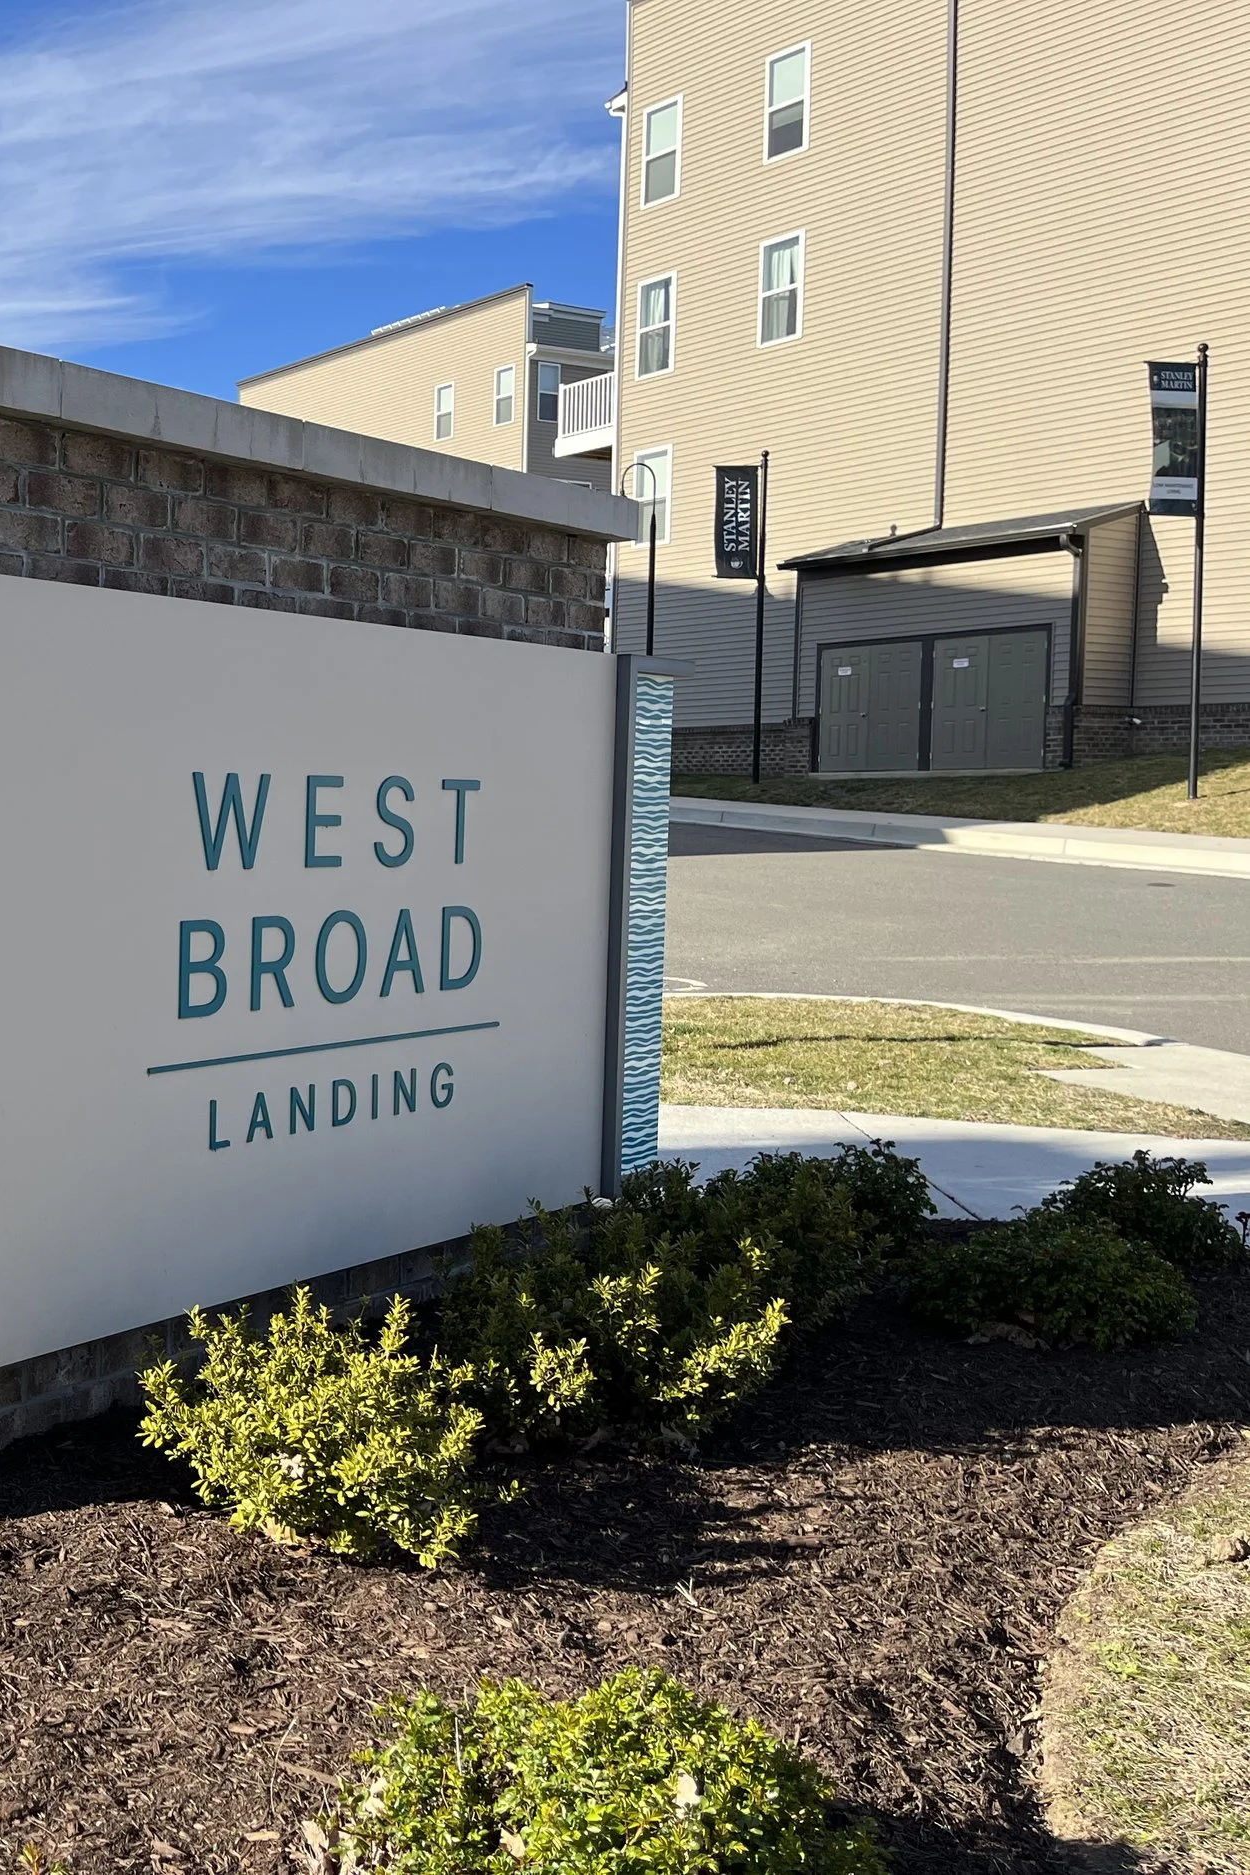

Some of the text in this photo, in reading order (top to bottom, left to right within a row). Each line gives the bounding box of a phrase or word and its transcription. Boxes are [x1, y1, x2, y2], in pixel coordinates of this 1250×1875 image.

[1160, 371, 1194, 380] STANLEY
[1160, 380, 1194, 389] MARTIN
[723, 476, 737, 552] STANLEY
[737, 479, 751, 552] MARTIN
[192, 771, 481, 871] WEST
[178, 905, 483, 1019] BROAD
[209, 1062, 455, 1151] LANDING
